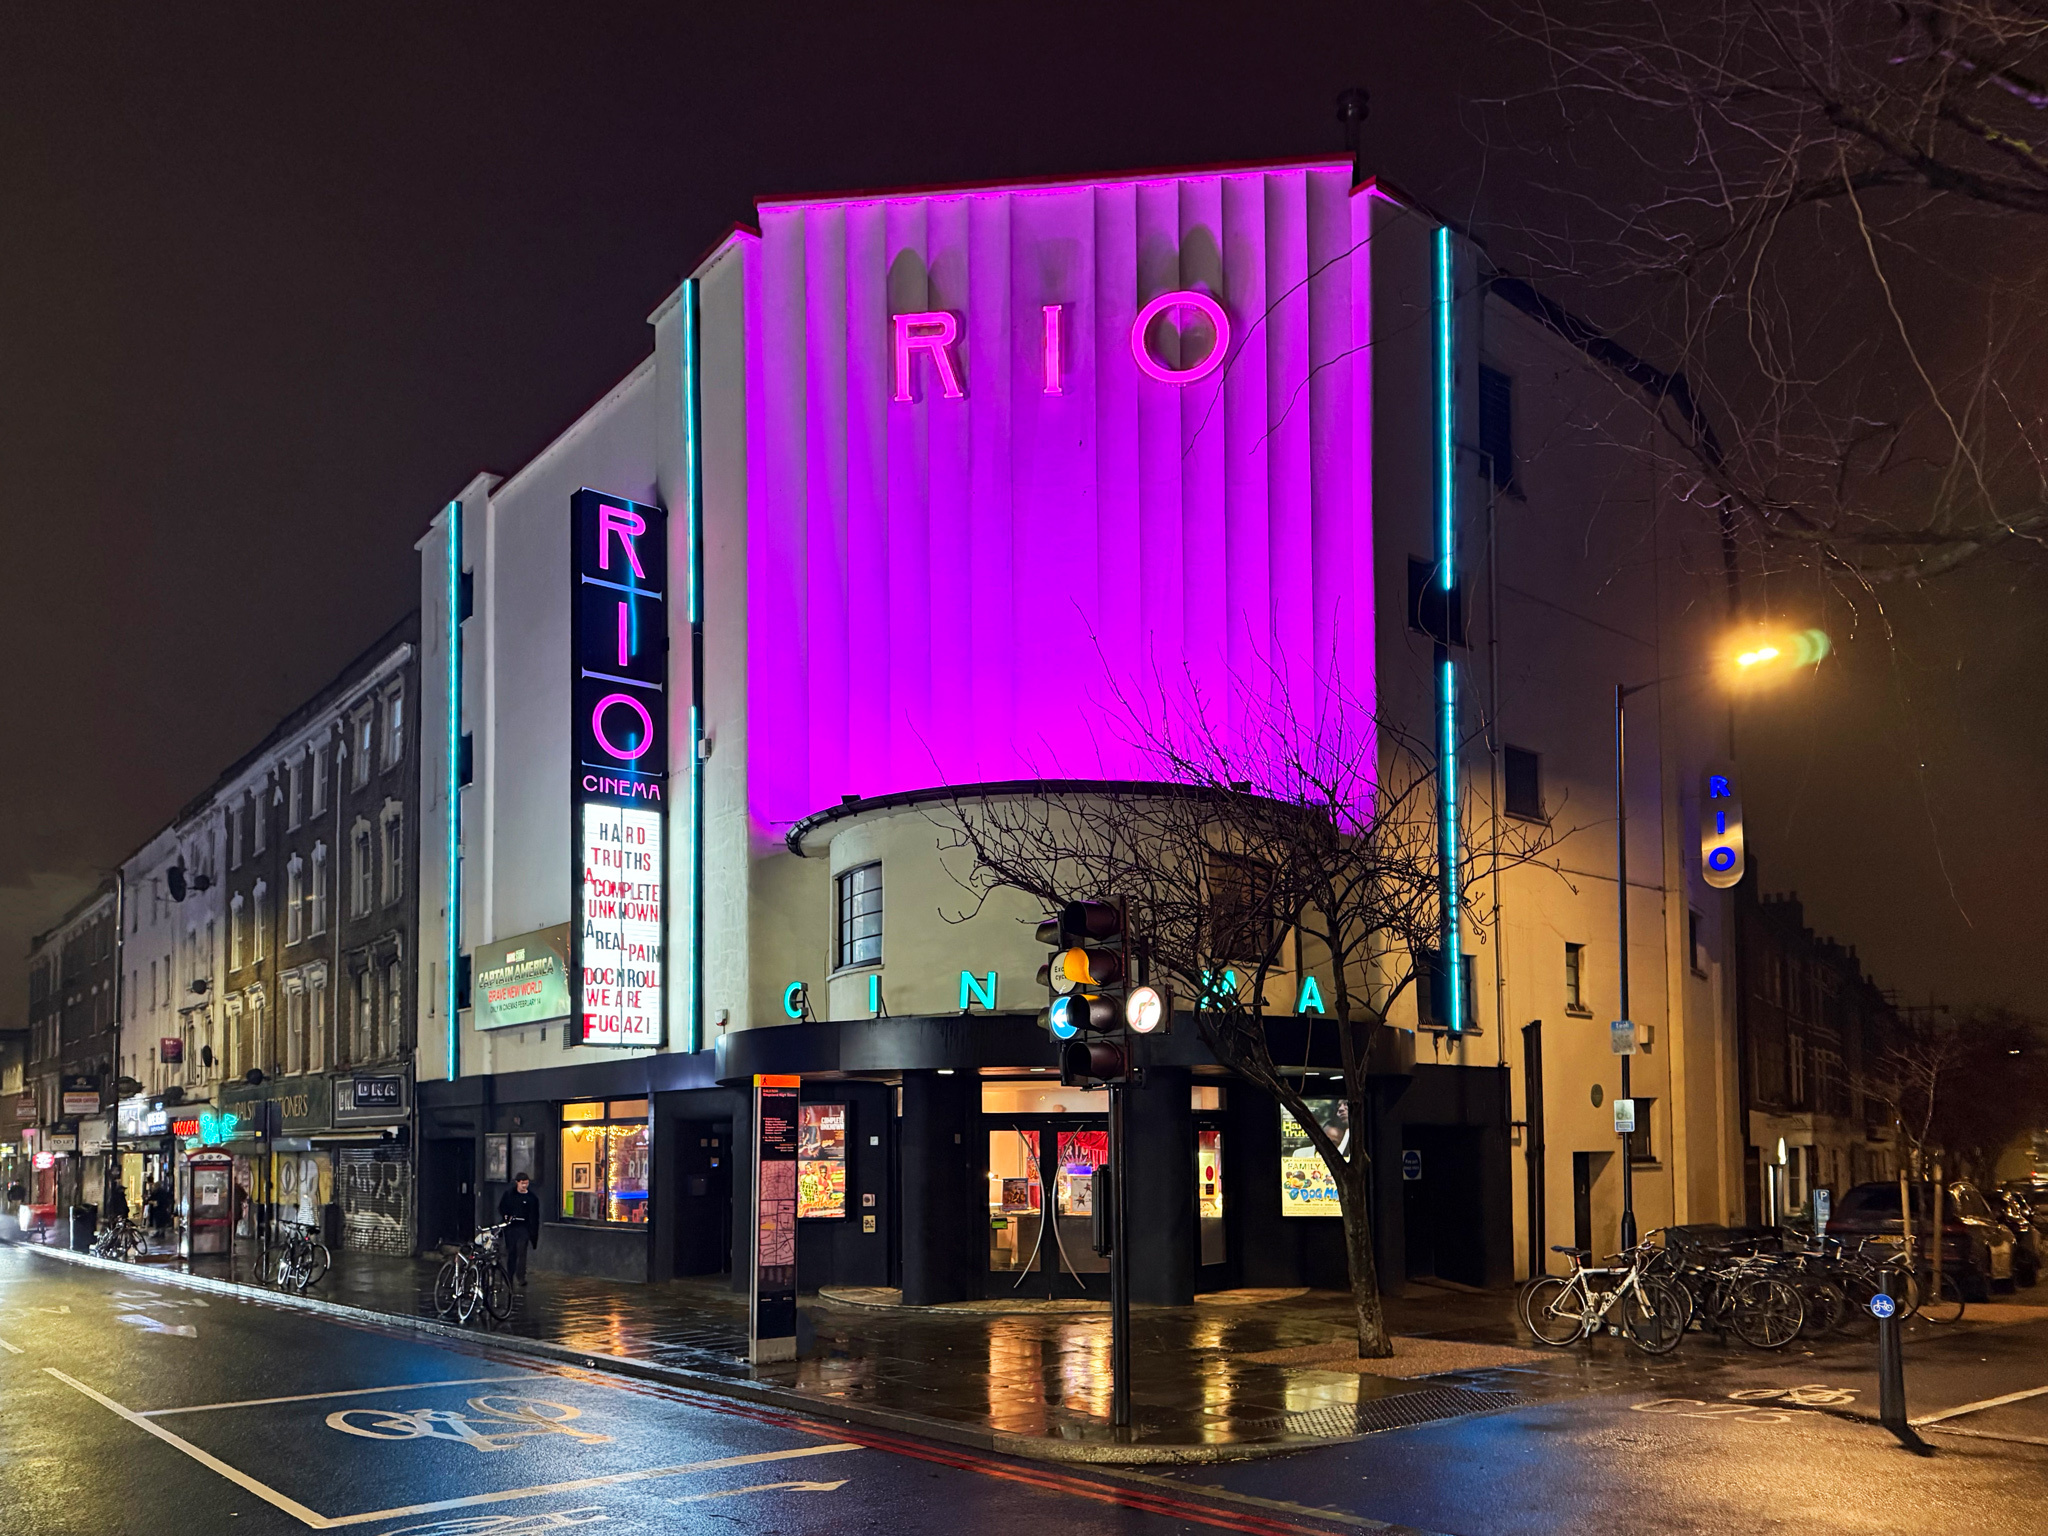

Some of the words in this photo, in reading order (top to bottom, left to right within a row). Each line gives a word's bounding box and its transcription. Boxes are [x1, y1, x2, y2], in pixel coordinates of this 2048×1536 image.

[892, 290, 1230, 402] RIO
[592, 504, 654, 760] RIO
[582, 775, 661, 801] CINEMA
[599, 822, 646, 845] HARD
[1708, 774, 1736, 872] RIO
[590, 847, 651, 871] TRUTHS
[584, 867, 594, 885] A
[593, 878, 660, 902] COMPLETE
[588, 899, 659, 923] UNKNOWN
[585, 919, 595, 939] A
[595, 930, 628, 951] REAL
[628, 943, 661, 963] PAIN
[478, 965, 515, 988] CAPTAIN
[514, 956, 554, 981] AMERICA
[488, 987, 507, 1003] BRAVE
[507, 985, 520, 999] NEW
[520, 980, 543, 996] WORLD
[585, 987, 611, 1008] WE
[614, 990, 642, 1009] ARE
[583, 1013, 650, 1039] FUGAZI
[357, 1082, 397, 1097] DNA
[1287, 1163, 1321, 1171] FAMILY
[1300, 1187, 1323, 1203] DOG
